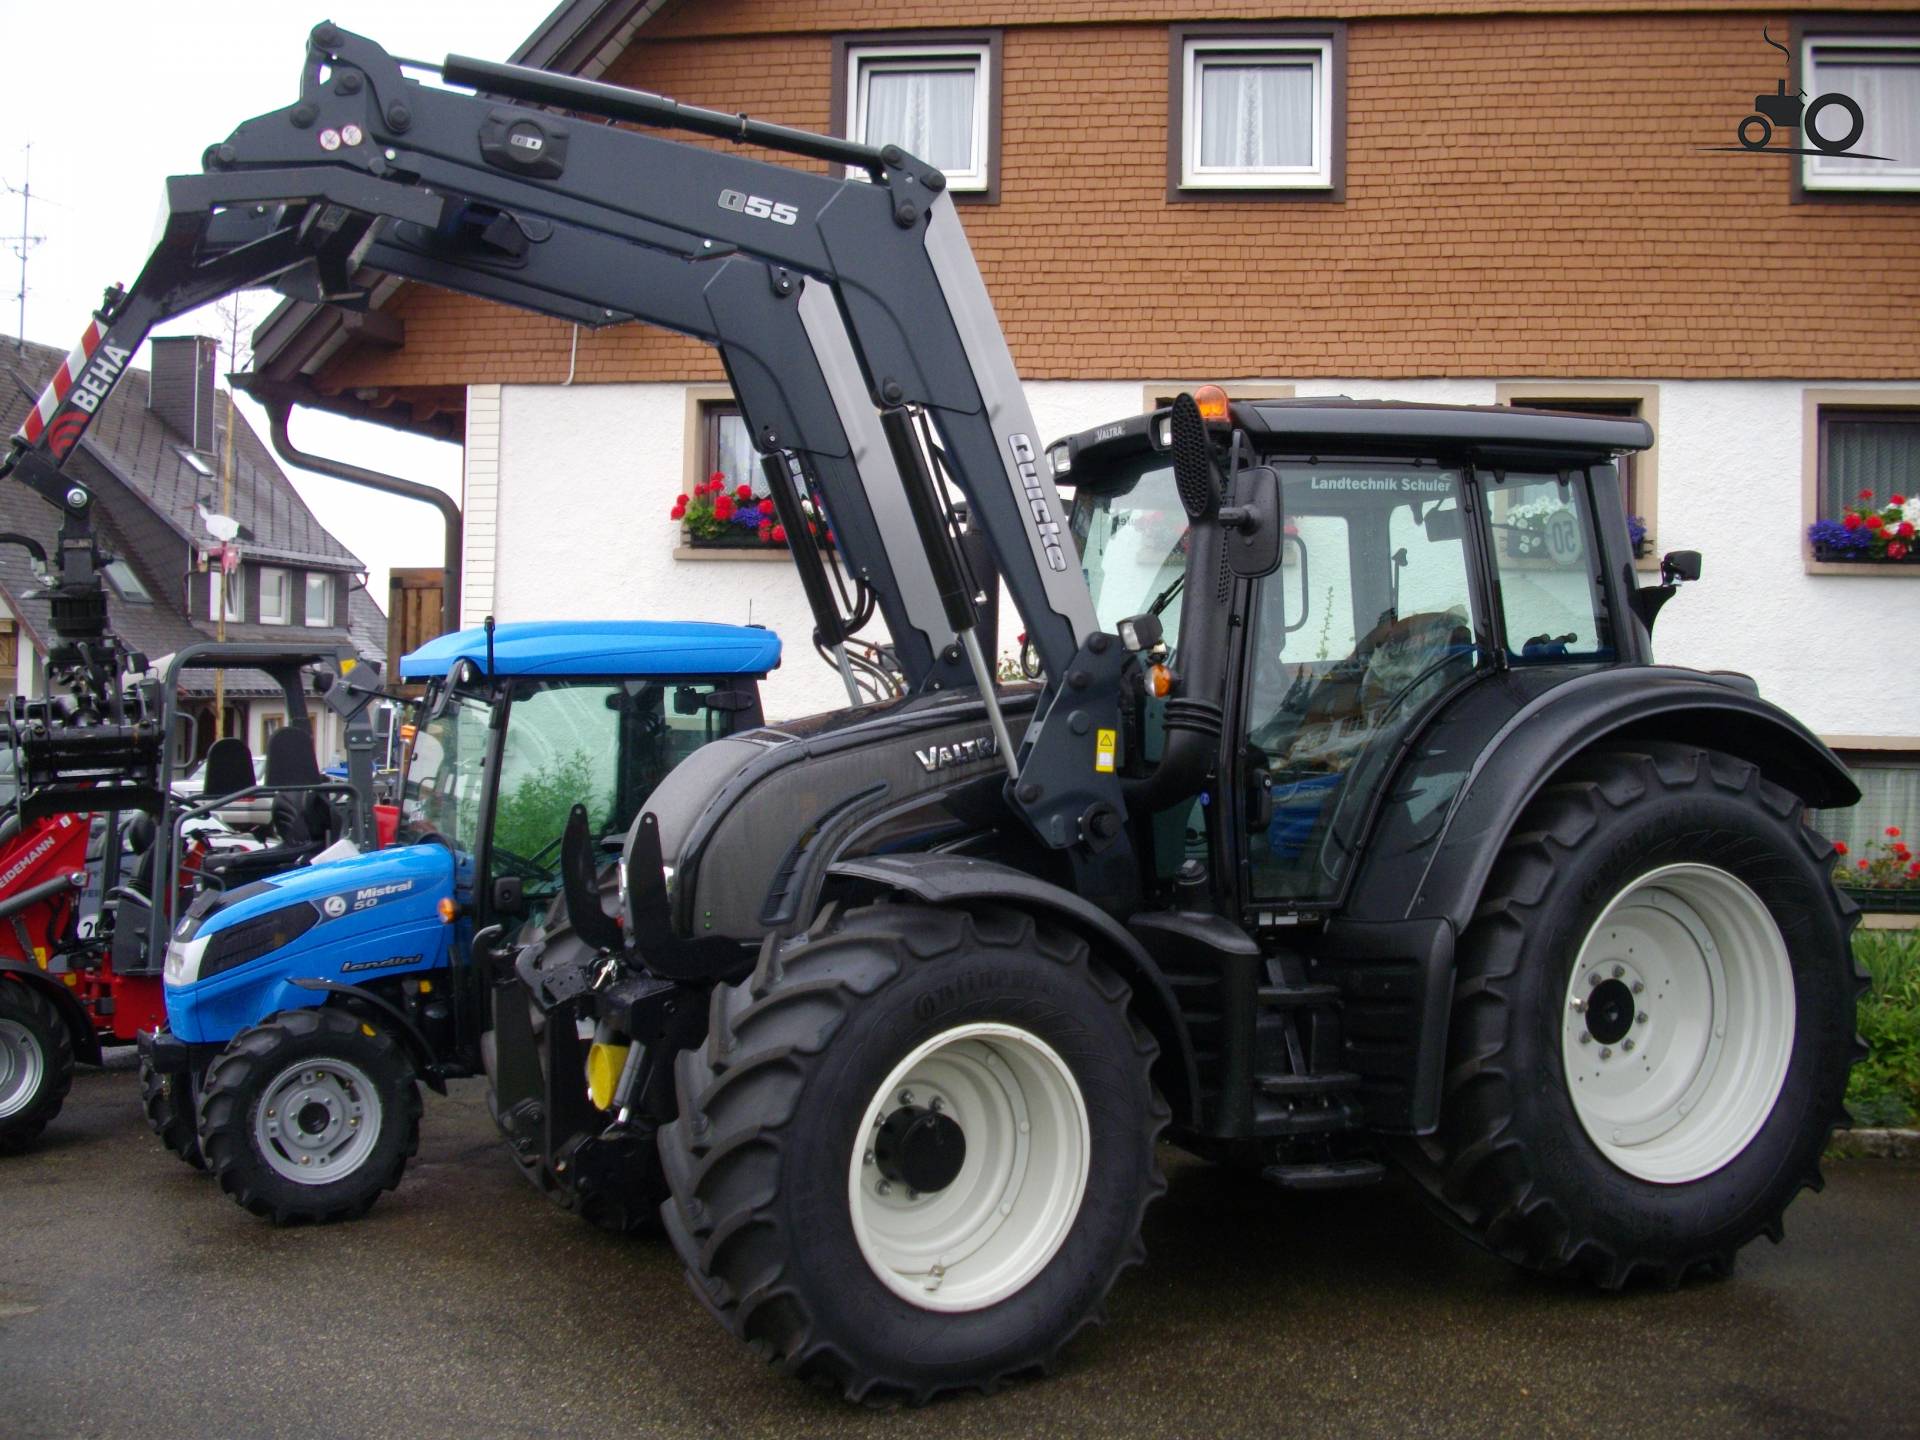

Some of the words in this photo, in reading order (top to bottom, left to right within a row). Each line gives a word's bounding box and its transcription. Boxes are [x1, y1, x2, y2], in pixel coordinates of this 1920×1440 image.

[70, 345, 131, 414] BEHA
[1311, 477, 1398, 490] Landtechnik
[1401, 478, 1451, 492] Schuler
[357, 880, 413, 900] Mistral
